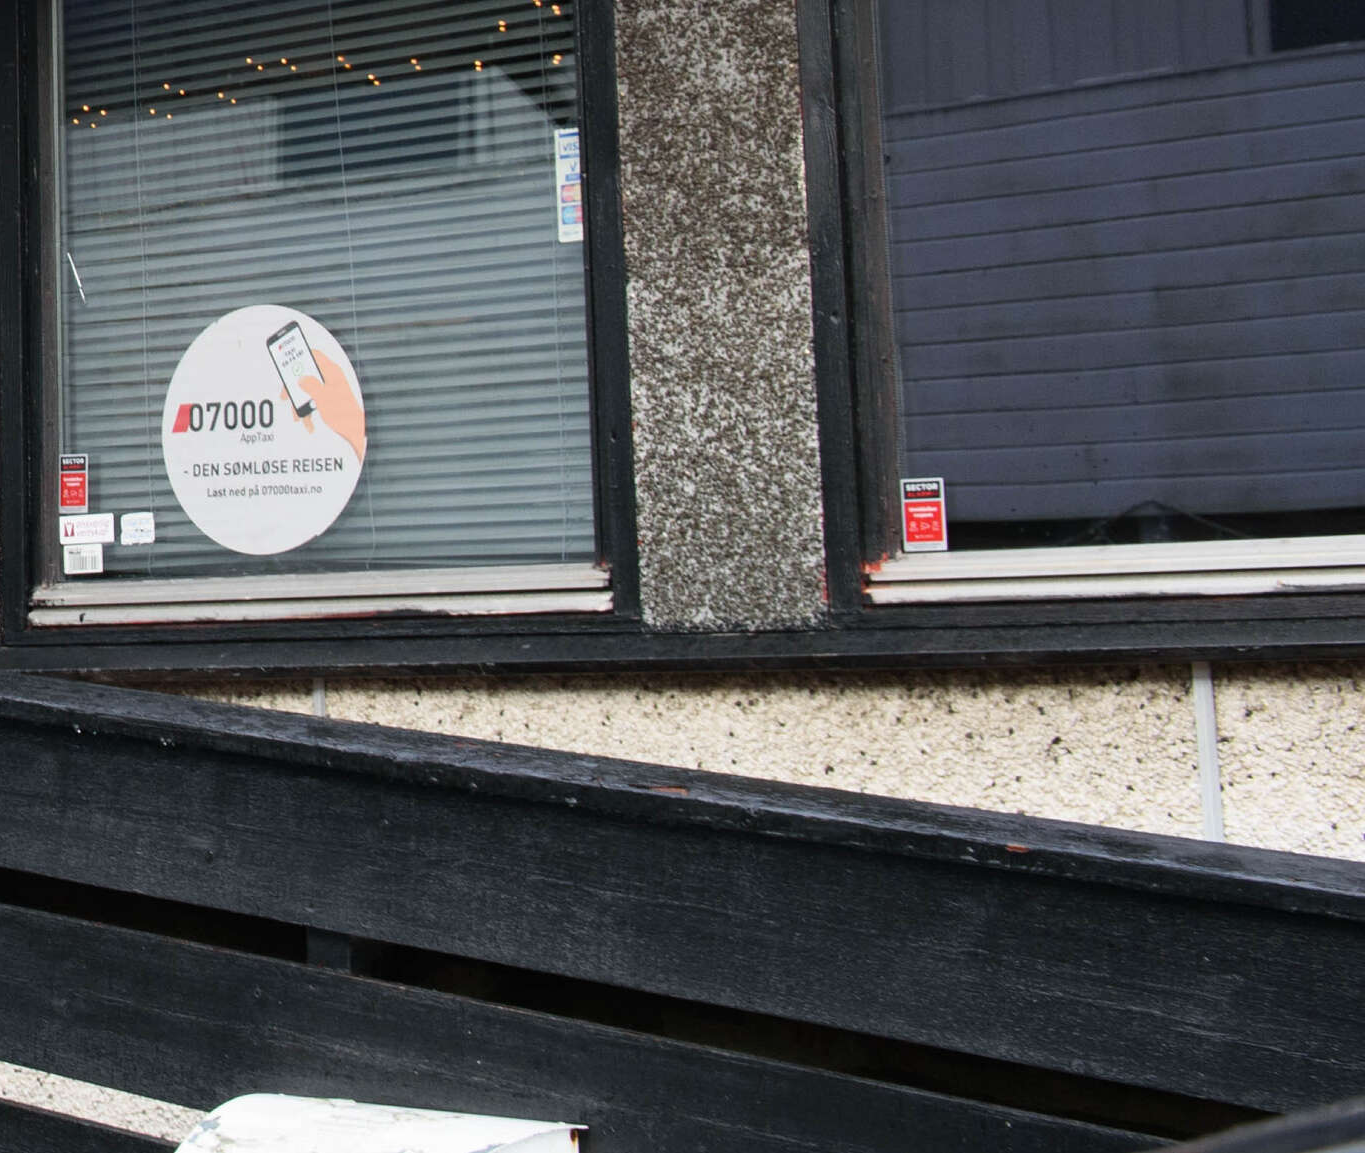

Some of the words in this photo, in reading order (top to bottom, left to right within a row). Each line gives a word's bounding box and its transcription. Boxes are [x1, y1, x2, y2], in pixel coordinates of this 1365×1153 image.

[562, 141, 579, 152] VIS
[189, 399, 274, 432] 07000
[240, 431, 275, 444] AppTaxi
[193, 463, 220, 477] DEN
[223, 459, 288, 476] SØMLØSE
[292, 457, 344, 473] REISEN
[207, 487, 226, 497] Last
[229, 486, 246, 497] ned
[248, 485, 260, 498] på
[261, 484, 323, 496] 07000taxi.no
